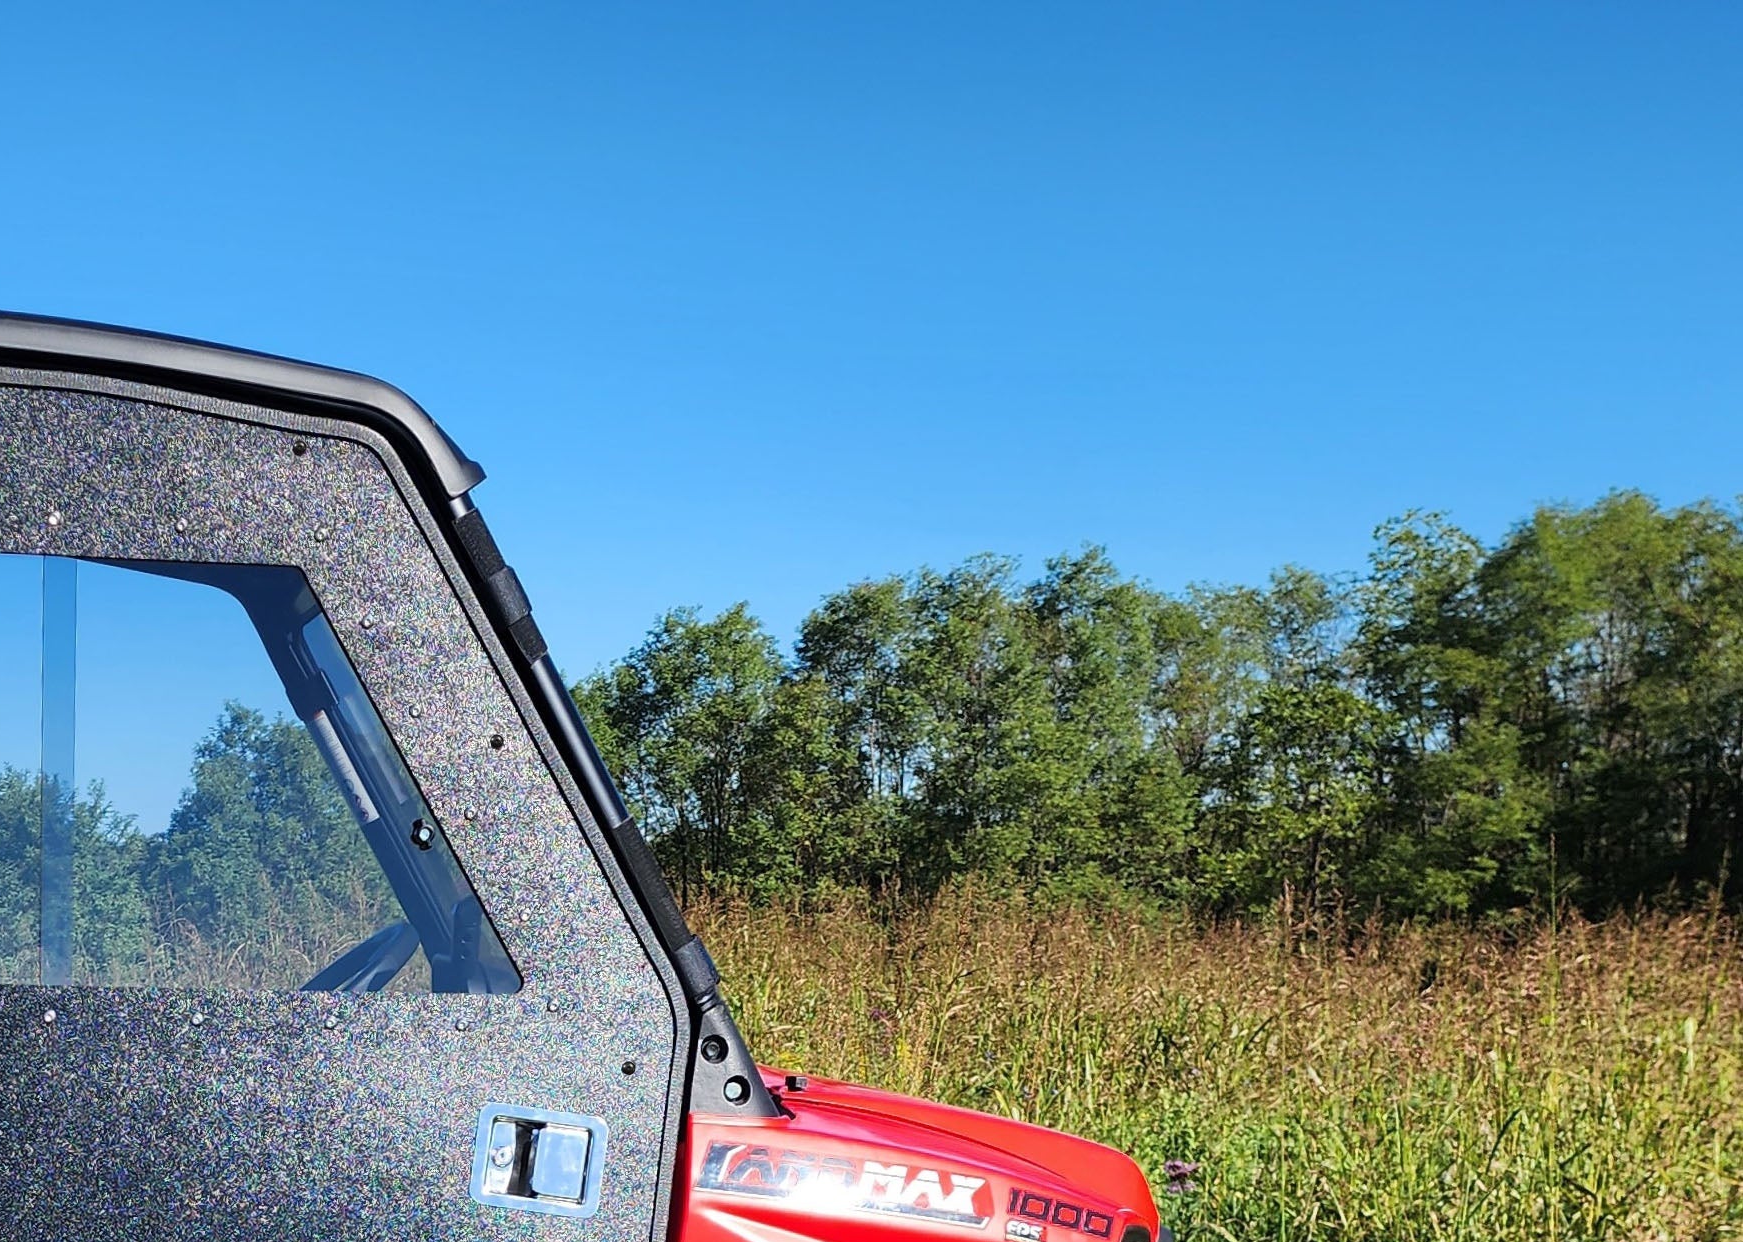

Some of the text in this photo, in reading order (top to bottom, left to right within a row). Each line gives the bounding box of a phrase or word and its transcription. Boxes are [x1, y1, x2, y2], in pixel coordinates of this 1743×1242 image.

[694, 1140, 1114, 1239] LANDMAX 1000
[1005, 1220, 1044, 1241] EPS
